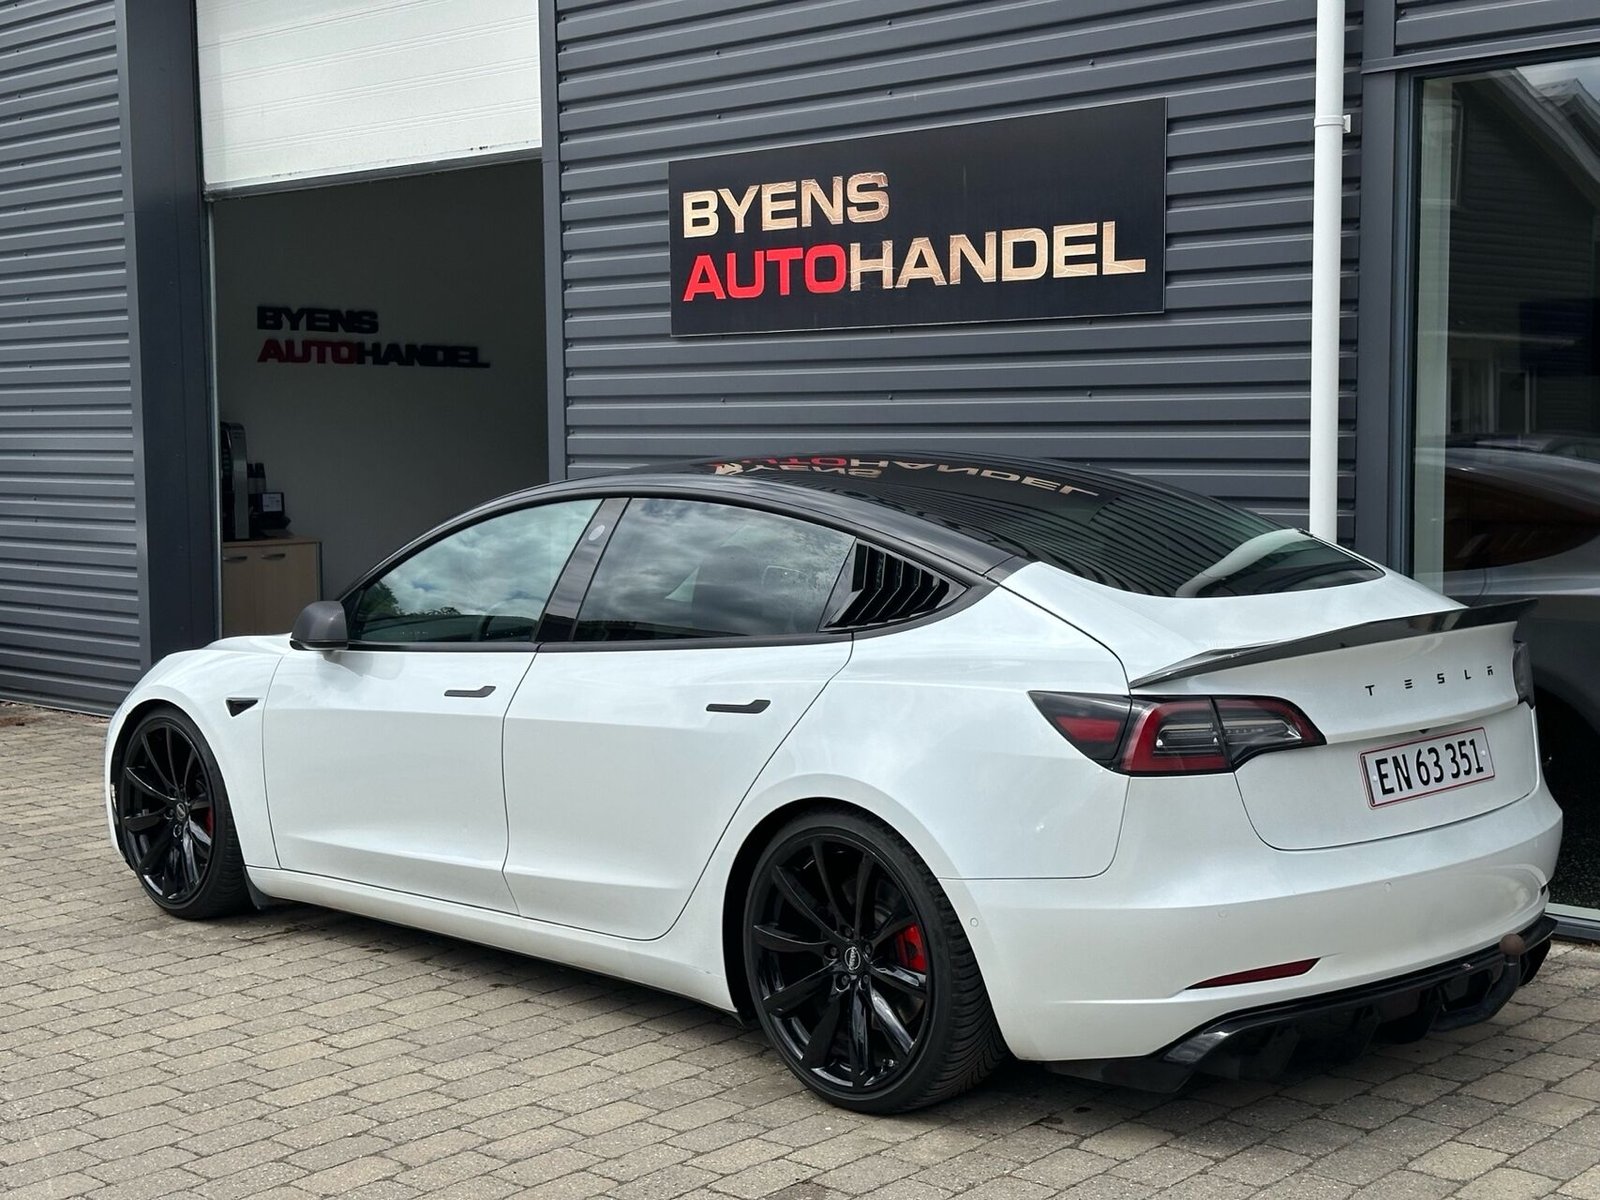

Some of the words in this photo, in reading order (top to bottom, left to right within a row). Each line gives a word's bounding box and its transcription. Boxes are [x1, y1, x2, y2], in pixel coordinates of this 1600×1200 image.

[683, 171, 889, 238] BYENS
[683, 220, 1146, 302] AUTOHANDEL
[257, 305, 379, 334] BYENS
[257, 339, 490, 368] AUTOHANDEL
[1365, 665, 1494, 696] TESLA
[1375, 753, 1413, 795] EN
[1416, 747, 1444, 786] 63
[1445, 738, 1484, 779] 351
